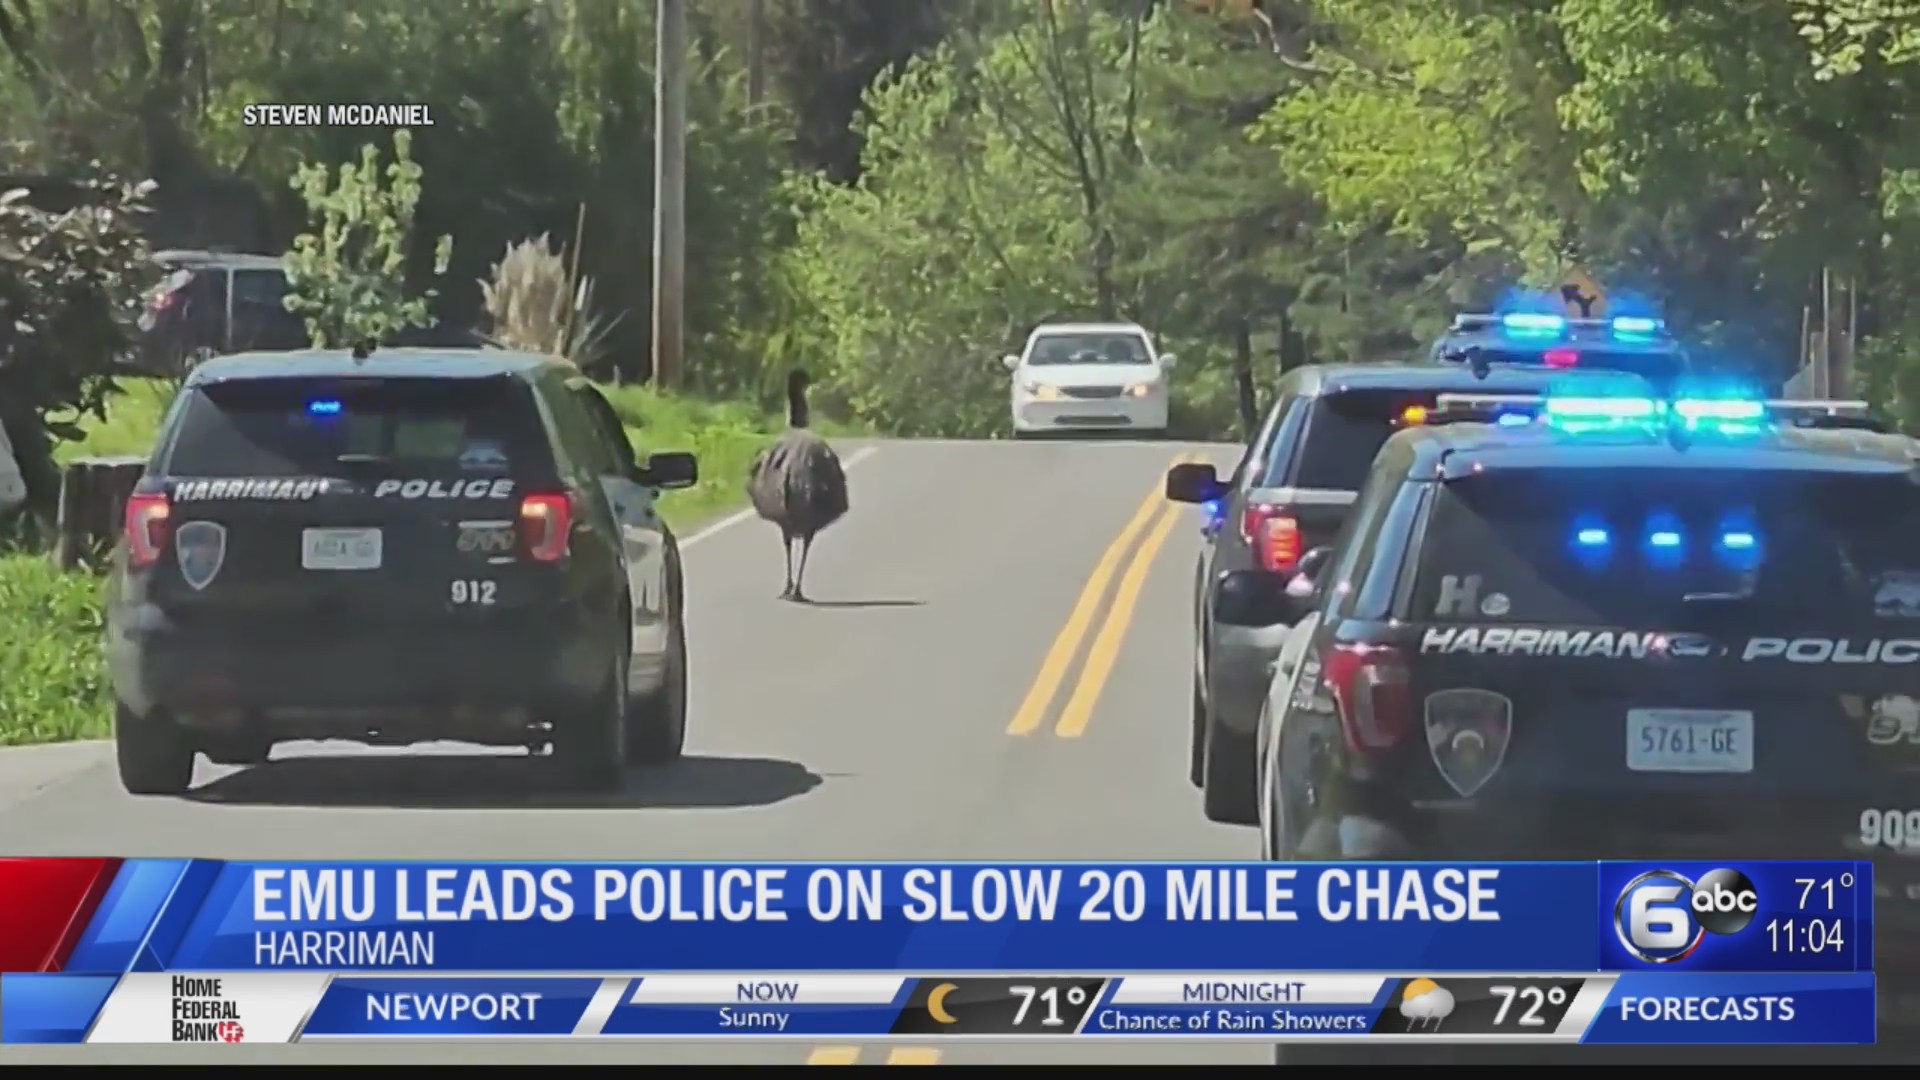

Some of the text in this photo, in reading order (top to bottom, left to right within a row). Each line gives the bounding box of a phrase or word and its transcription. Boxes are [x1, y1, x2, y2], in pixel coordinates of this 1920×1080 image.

[174, 479, 514, 501] HARRIMAN POLICE
[452, 580, 497, 604] 912
[1420, 627, 1653, 659] HARRIMAN
[1641, 727, 1739, 754] 5761-GE
[1860, 808, 1920, 846] 909
